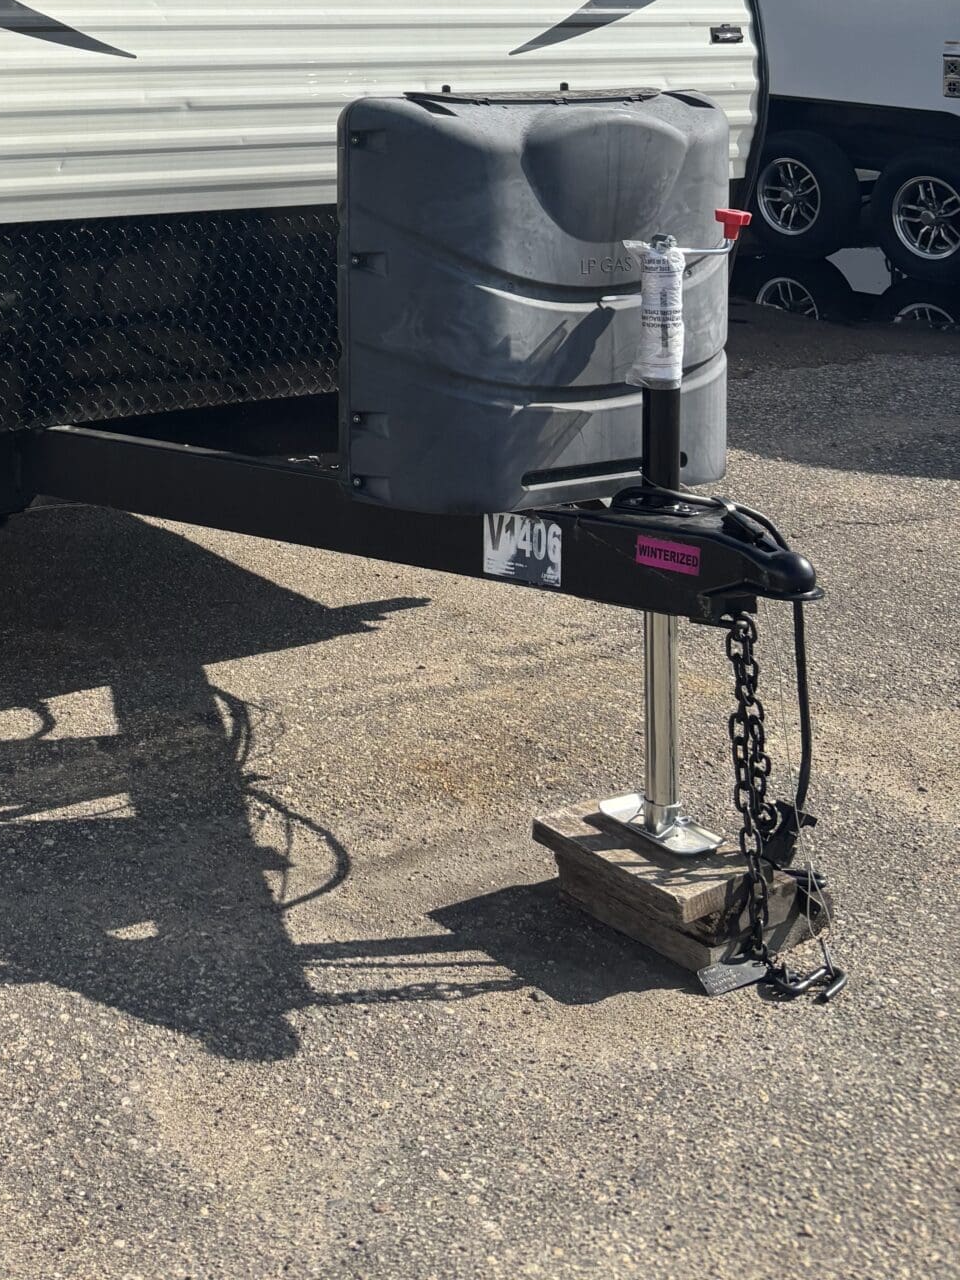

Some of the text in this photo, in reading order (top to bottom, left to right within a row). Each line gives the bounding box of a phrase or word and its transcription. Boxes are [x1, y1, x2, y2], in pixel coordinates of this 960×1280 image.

[581, 258, 597, 275] LP
[601, 256, 633, 274] GAS
[638, 544, 699, 569] WINTERIZED
